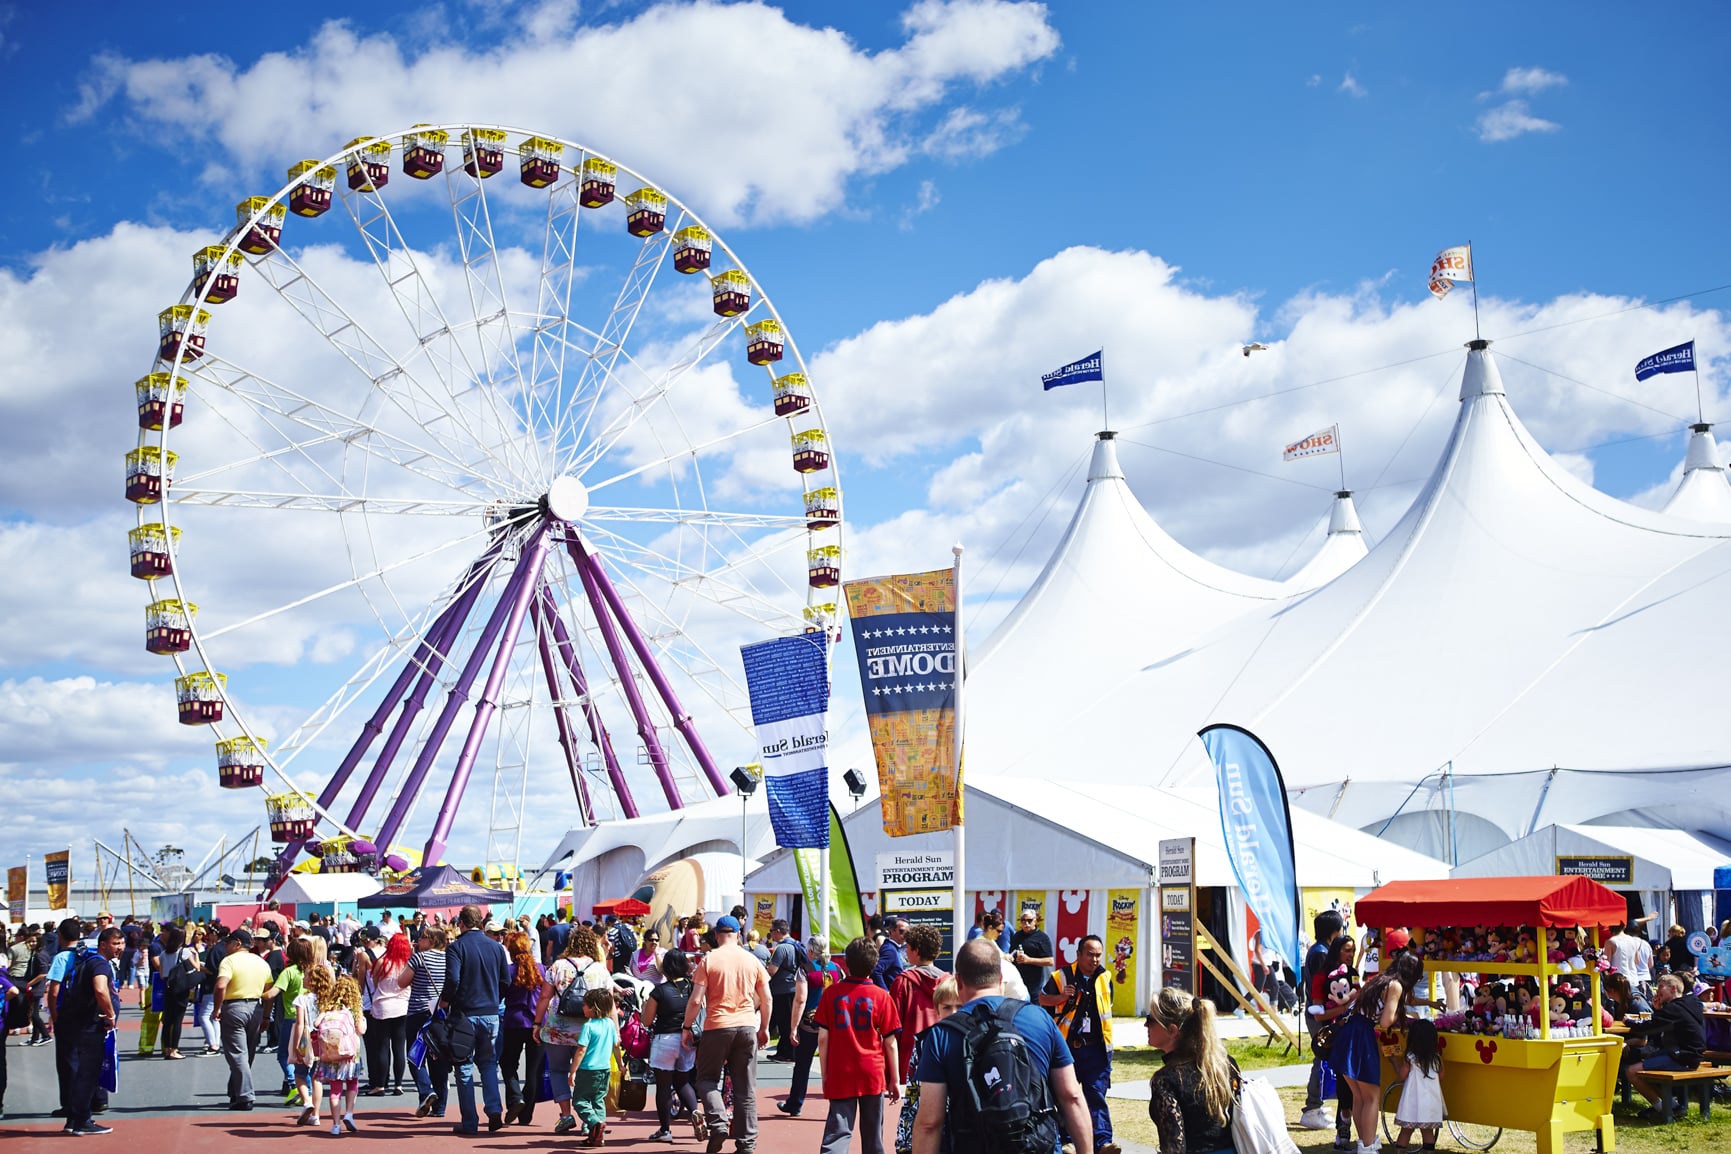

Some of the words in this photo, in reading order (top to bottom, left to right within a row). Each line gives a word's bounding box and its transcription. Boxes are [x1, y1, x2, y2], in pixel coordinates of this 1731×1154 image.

[894, 856, 923, 864] Herald
[925, 855, 942, 863] Sun
[1161, 864, 1189, 878] PROGRAM
[883, 871, 954, 884] PROGRAM
[898, 896, 940, 906] TODAY
[1167, 894, 1184, 906] TODAY
